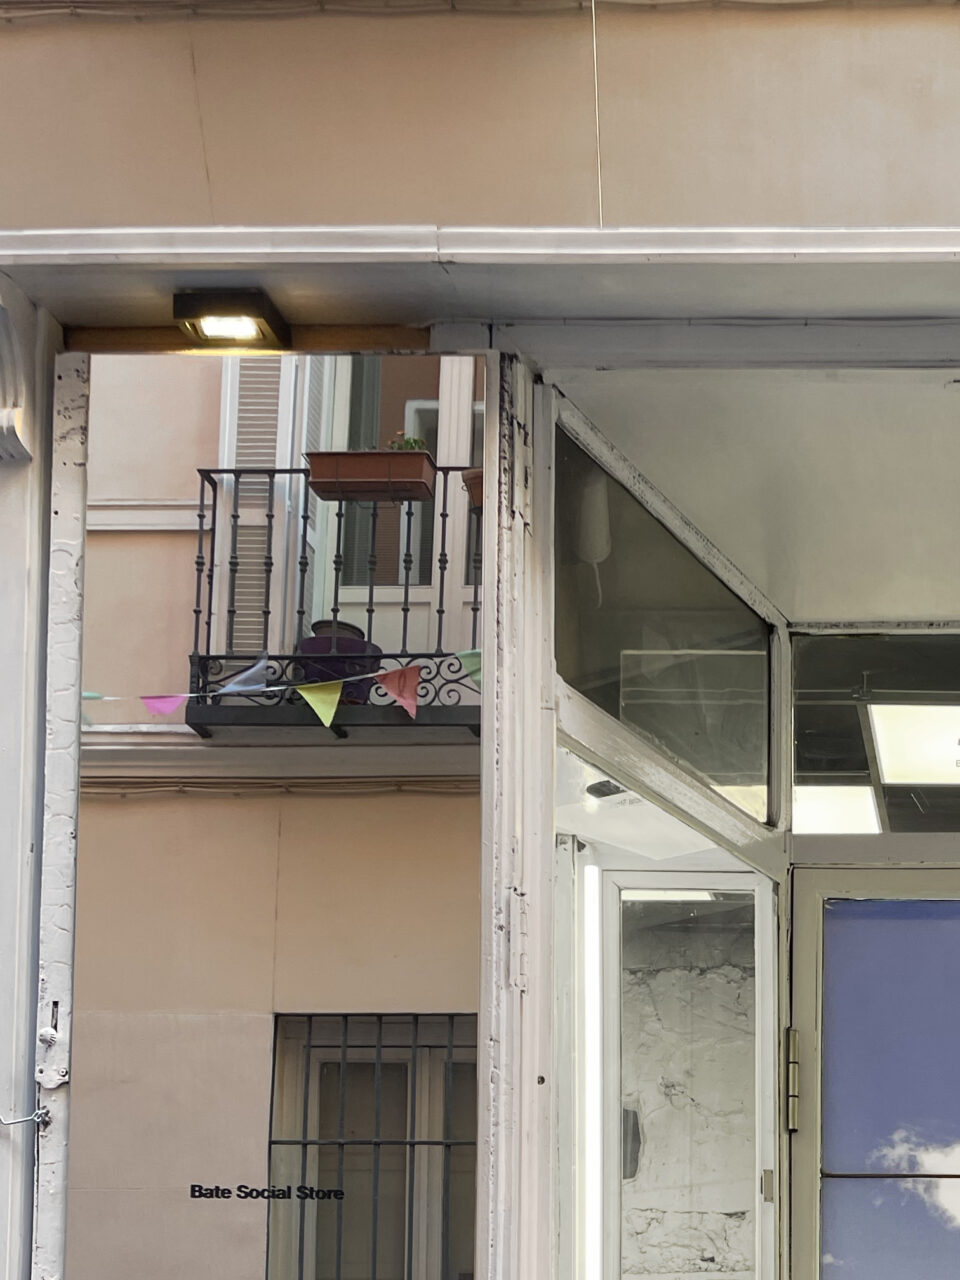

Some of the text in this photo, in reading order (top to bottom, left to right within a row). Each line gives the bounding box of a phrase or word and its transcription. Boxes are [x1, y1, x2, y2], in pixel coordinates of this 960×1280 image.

[190, 1184, 345, 1200] Bate Social Store
